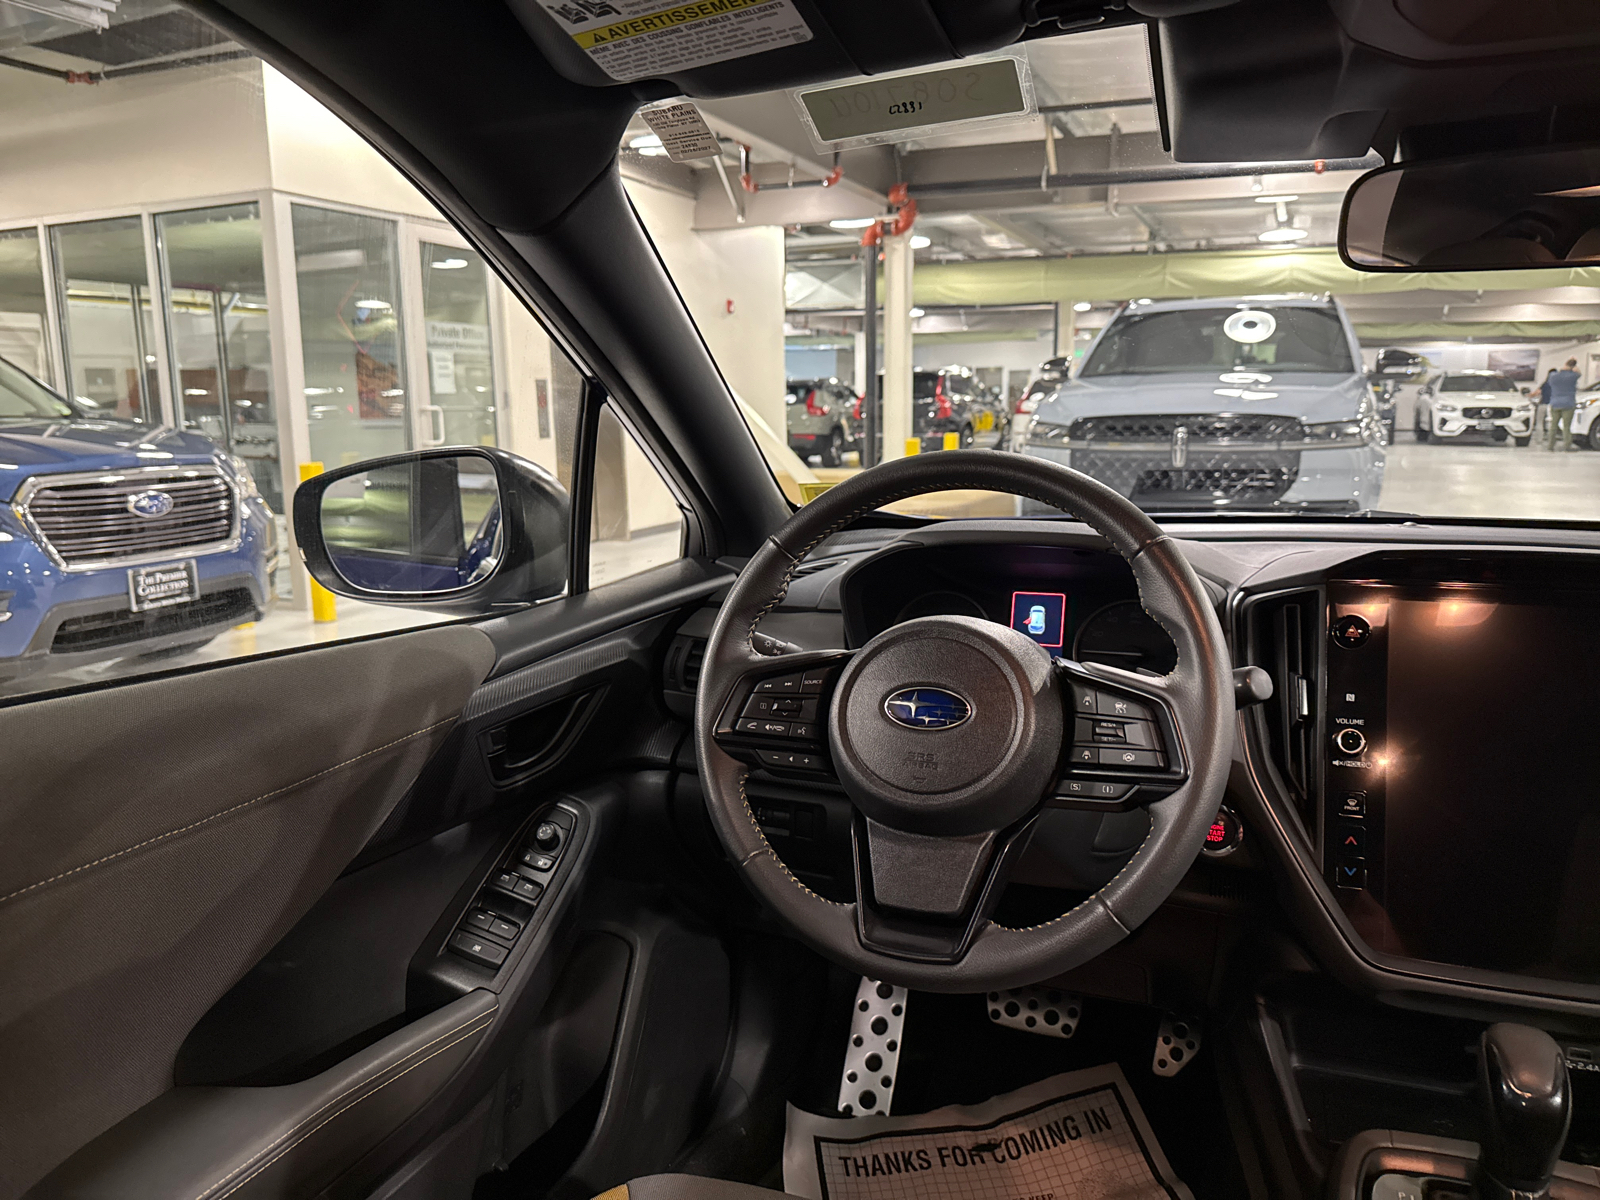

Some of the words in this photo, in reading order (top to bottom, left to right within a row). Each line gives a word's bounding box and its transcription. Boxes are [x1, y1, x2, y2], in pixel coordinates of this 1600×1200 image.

[608, 0, 757, 38] AVERTISSEME
[612, 40, 631, 50] AVEC
[631, 36, 647, 45] DES
[647, 26, 683, 40] COUSSINS
[684, 15, 732, 31] GONFLABLES
[733, 1, 785, 19] INTELLIGENTS
[648, 115, 670, 123] WHITE
[671, 109, 697, 118] PLAINS
[651, 105, 683, 116] SUBARU
[1335, 718, 1365, 726] VOLUME
[1210, 829, 1225, 837] TART
[839, 1150, 932, 1178] THANKS
[938, 1146, 985, 1168] FOR
[990, 1115, 1083, 1164] COMING
[1084, 1106, 1113, 1134] IN
